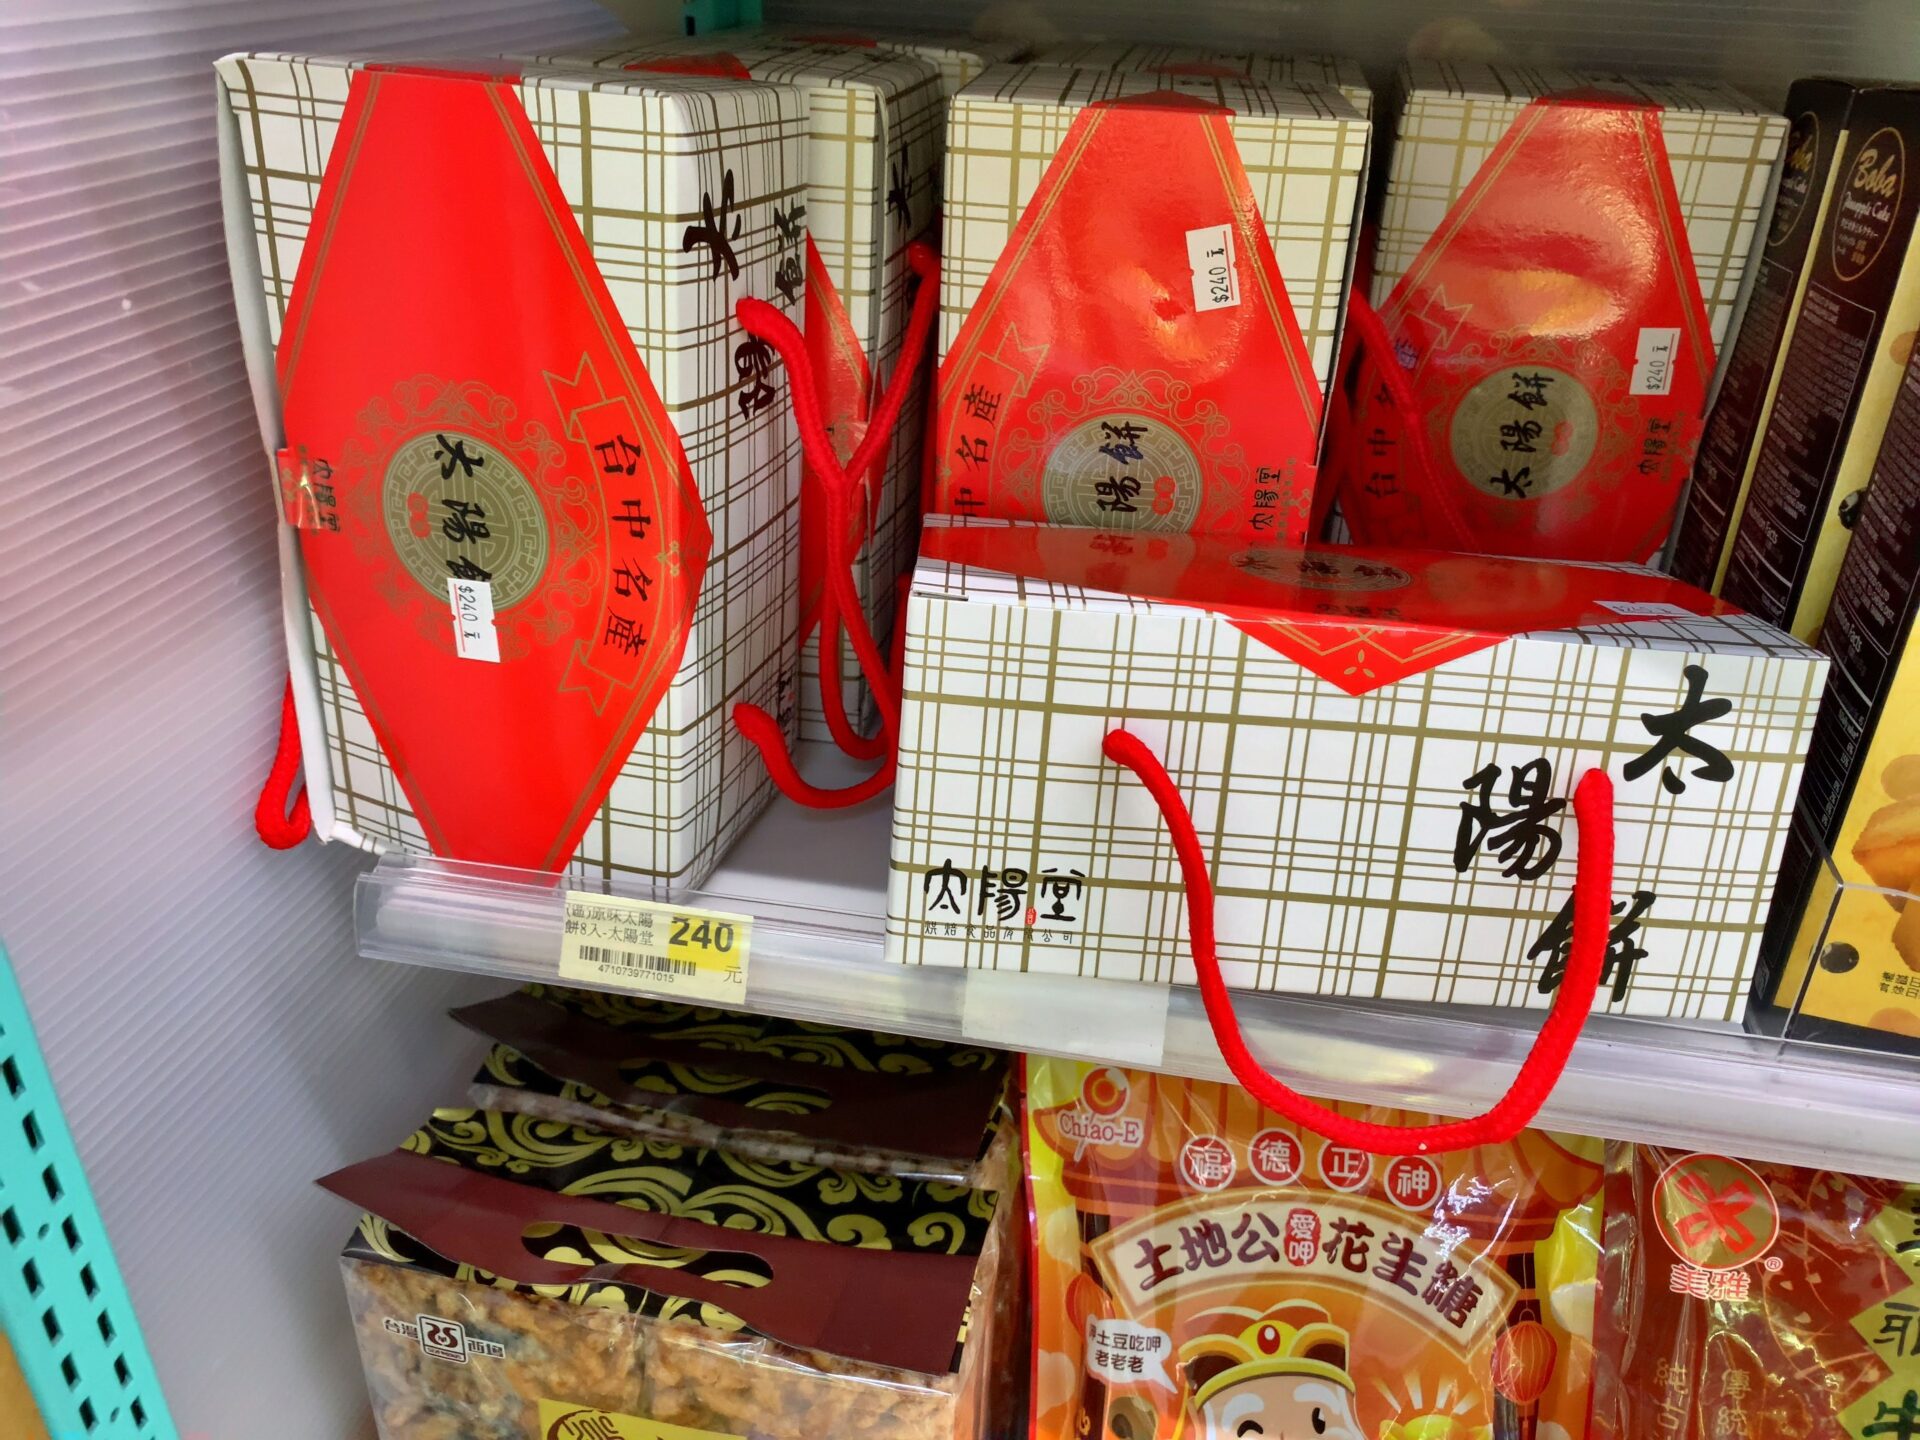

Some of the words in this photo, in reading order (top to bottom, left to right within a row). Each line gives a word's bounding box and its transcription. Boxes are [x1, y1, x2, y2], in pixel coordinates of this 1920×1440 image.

[1853, 148, 1897, 198] Boba
[1208, 266, 1230, 304] $240
[1646, 359, 1666, 391] $240
[1490, 371, 1555, 499] 太陽餅
[1248, 466, 1282, 531] 太陽堂
[594, 434, 653, 658] 台中名產
[458, 585, 479, 622] $240
[924, 858, 1086, 922] 太陽堂
[669, 917, 735, 953] 240
[598, 963, 675, 983] 4710739771015
[723, 965, 743, 984] 元
[1059, 1112, 1140, 1145] Chiao-E
[1134, 1212, 1281, 1291] 土地公
[1669, 1264, 1752, 1302] 美雅
[1095, 1349, 1145, 1374] 老老老
